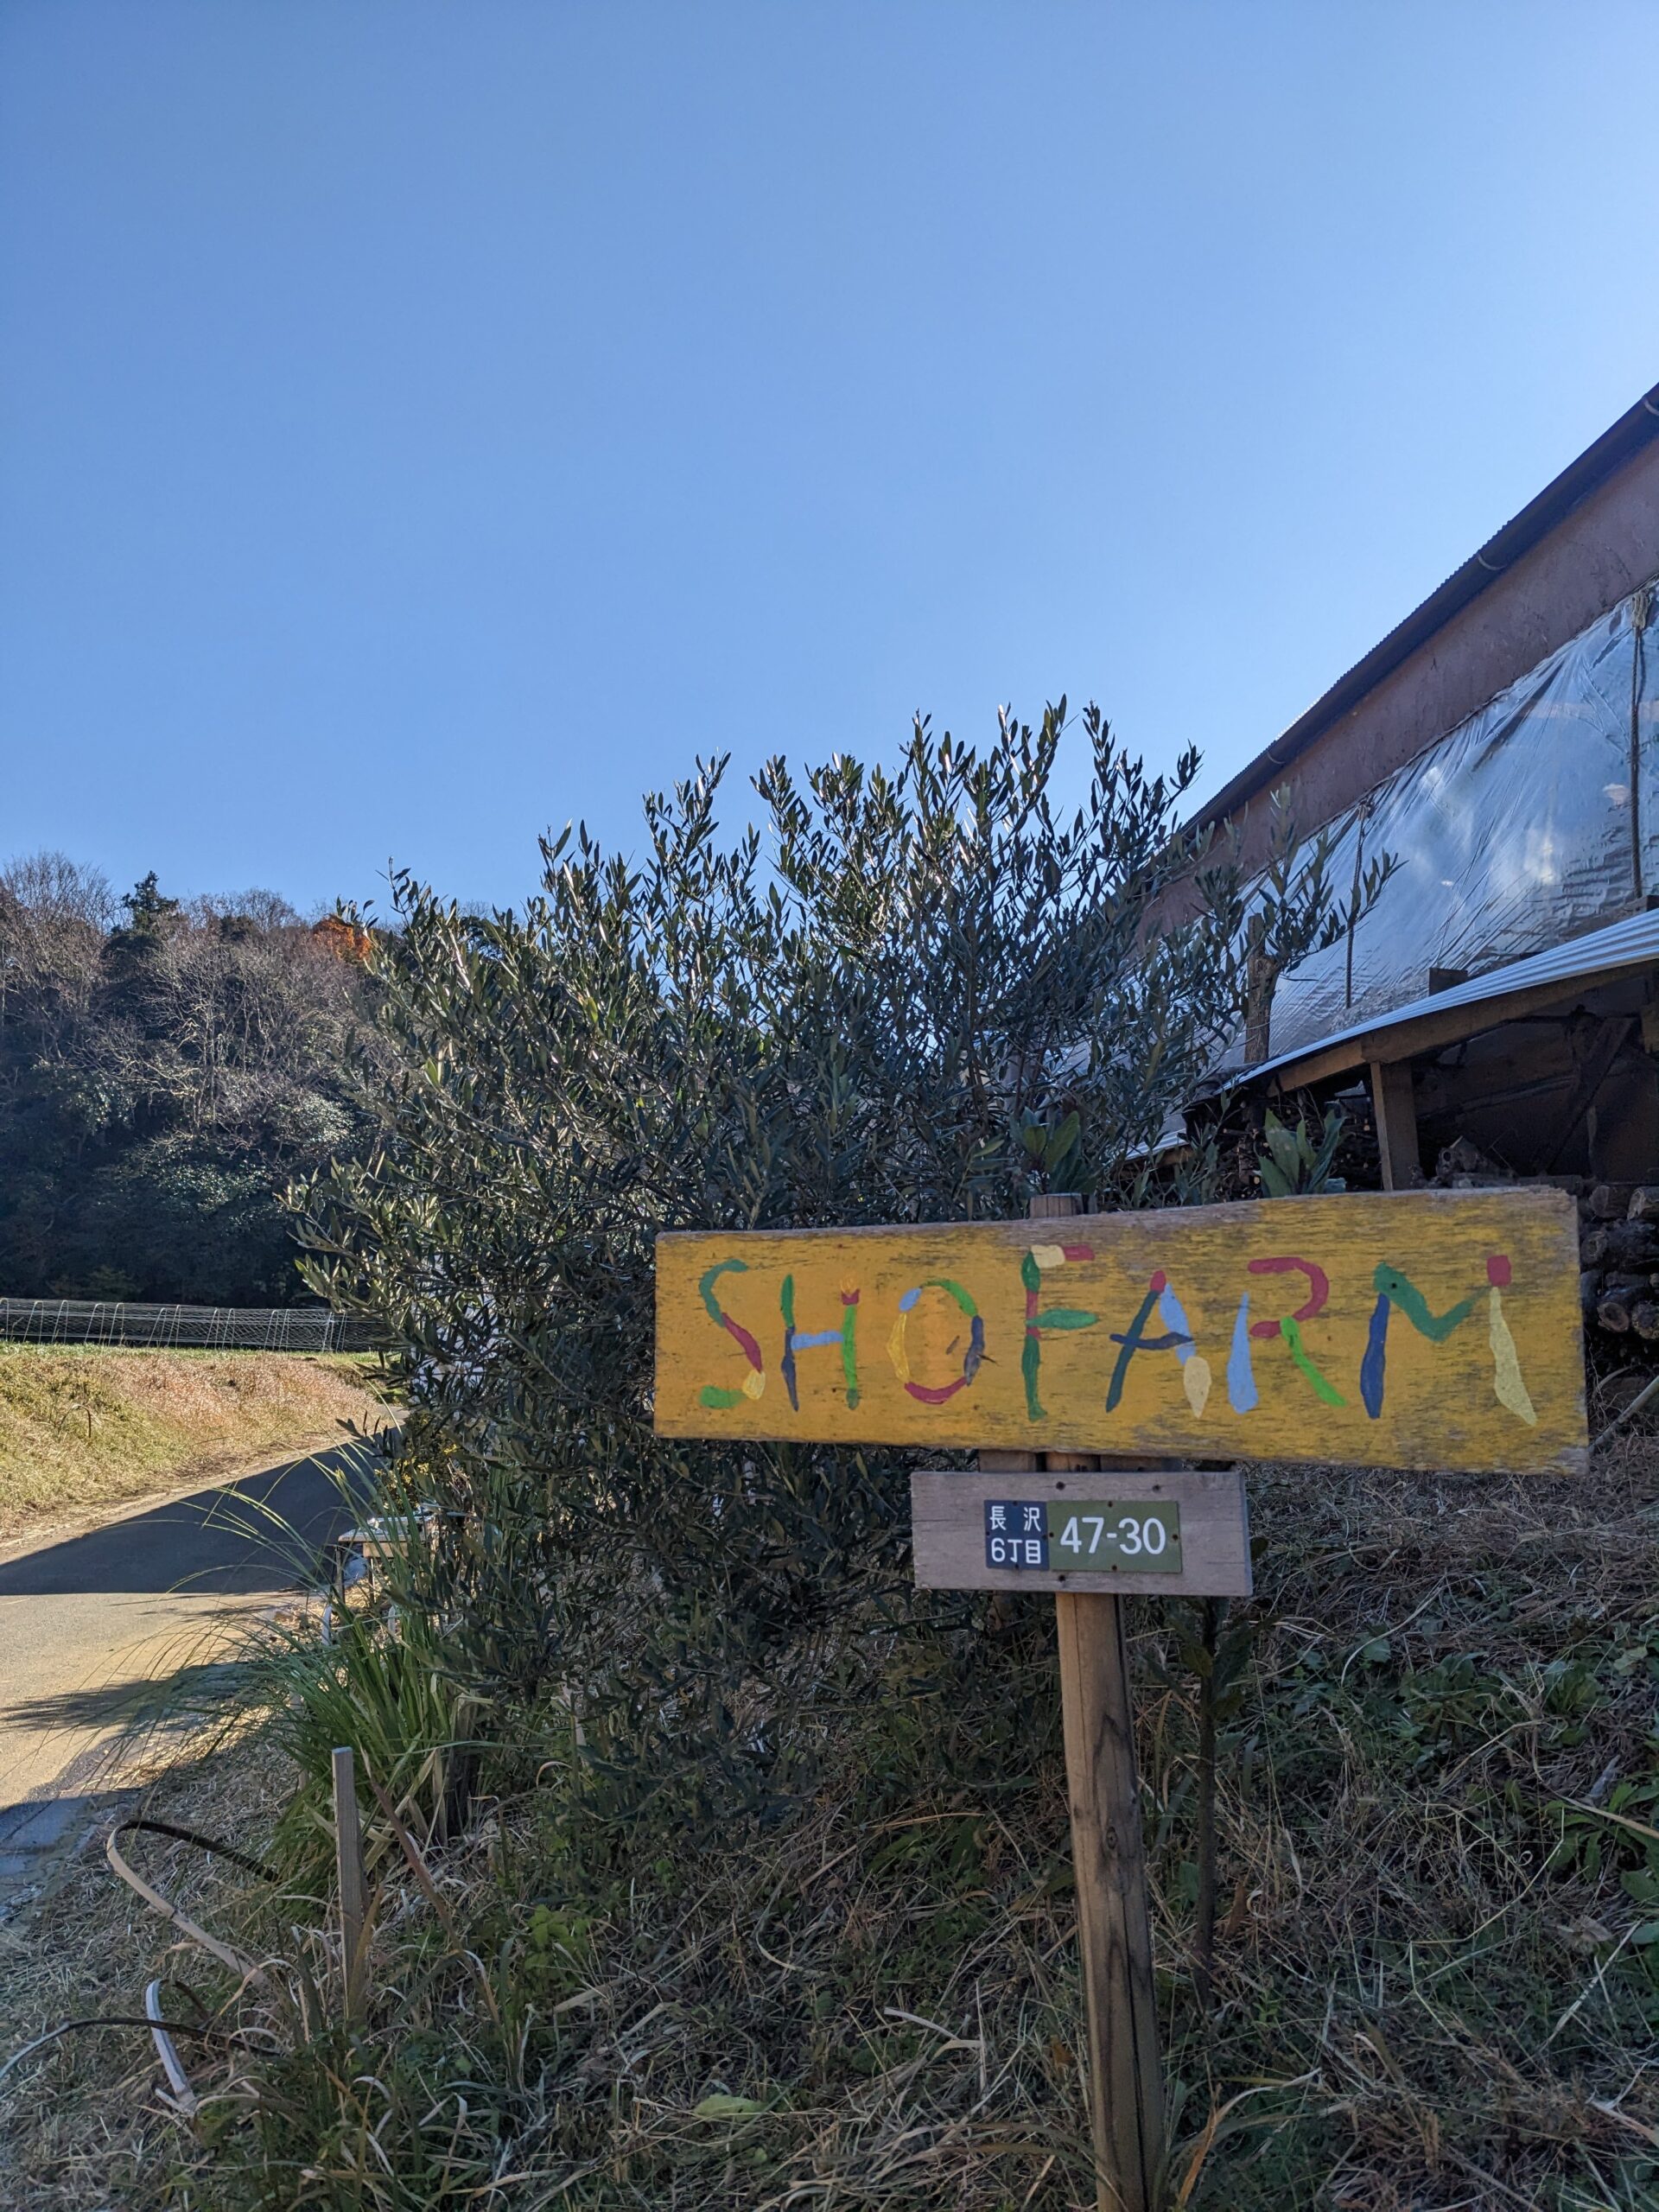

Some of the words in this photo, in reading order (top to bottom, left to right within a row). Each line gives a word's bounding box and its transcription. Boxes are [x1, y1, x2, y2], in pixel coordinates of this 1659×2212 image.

[988, 1505, 1041, 1532] 長沢
[1059, 1516, 1166, 1555] 47-30
[990, 1538, 1042, 1565] 6丁目
